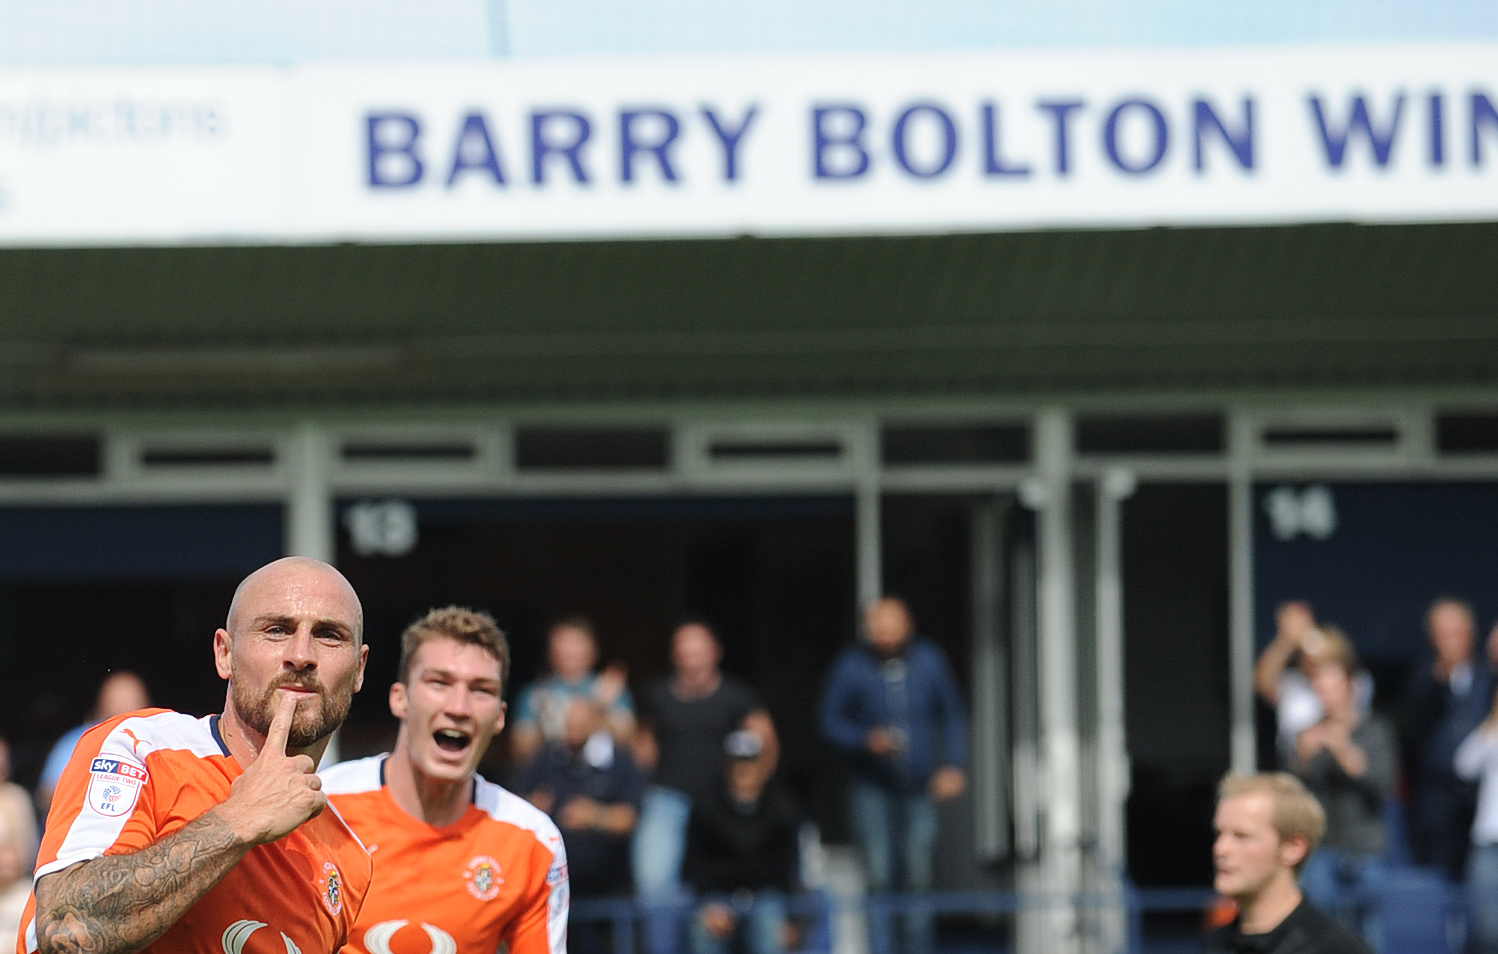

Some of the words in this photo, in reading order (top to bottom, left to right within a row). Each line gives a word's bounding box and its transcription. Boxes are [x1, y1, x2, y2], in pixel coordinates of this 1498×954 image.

[362, 101, 759, 192] BARRY
[807, 95, 1259, 185] BOLTON
[121, 764, 145, 779] BET
[101, 803, 115, 812] EFL
